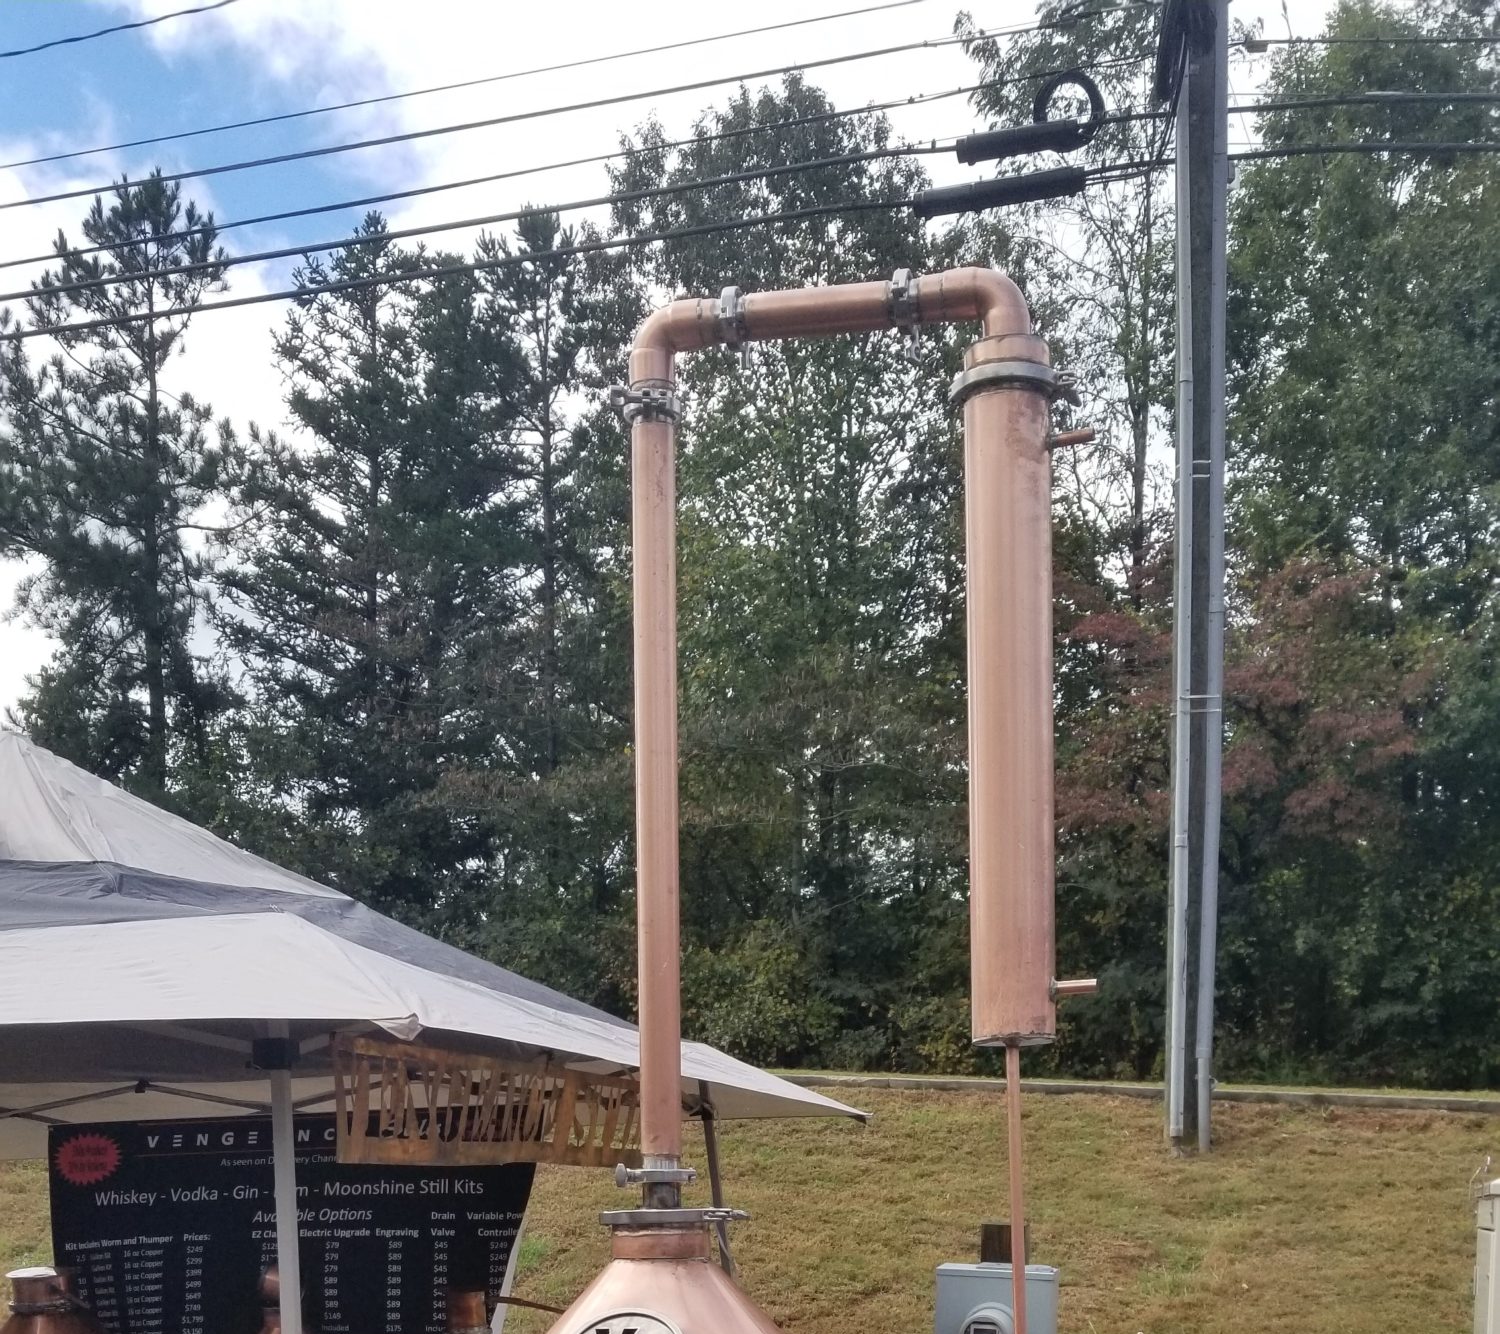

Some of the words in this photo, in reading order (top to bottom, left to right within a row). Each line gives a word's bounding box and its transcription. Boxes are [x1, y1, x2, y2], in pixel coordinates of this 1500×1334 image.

[147, 1128, 336, 1149] VENGENC
[221, 1158, 231, 1167] As
[232, 1158, 252, 1167] seen
[255, 1157, 266, 1166] on
[95, 1188, 157, 1206] Whiskey
[170, 1186, 218, 1202] Vodka
[233, 1185, 259, 1200] Gin
[324, 1179, 415, 1196] Moonshine
[419, 1178, 449, 1195] Still
[454, 1178, 484, 1195] Kits
[252, 1208, 316, 1223] Avable
[319, 1207, 373, 1224] Options
[431, 1211, 456, 1220] Drain
[467, 1211, 504, 1220] Variable
[251, 1230, 262, 1239] EZ
[263, 1230, 278, 1239] Cla
[300, 1228, 332, 1237] Electric
[333, 1228, 371, 1239] Upgrade
[375, 1228, 419, 1239] Engraving
[430, 1228, 456, 1237] Valve
[478, 1227, 519, 1237] Controlle
[65, 1242, 77, 1251] Kit
[101, 1238, 122, 1247] Worm
[123, 1236, 137, 1246] and
[138, 1234, 173, 1245] Thumper
[183, 1232, 211, 1243] Prices:
[141, 1248, 164, 1258] Copper
[325, 1241, 340, 1249] $79
[388, 1241, 402, 1249] $89
[434, 1241, 448, 1249] $45
[140, 1259, 164, 1269] Copper
[324, 1253, 339, 1261] $79
[388, 1253, 402, 1261] $89
[434, 1252, 448, 1261] $45
[140, 1271, 164, 1280] Copper
[324, 1264, 338, 1272] $79
[387, 1265, 402, 1273] $89
[433, 1264, 448, 1273] $45
[324, 1276, 338, 1284] $89
[387, 1276, 401, 1285] $89
[433, 1276, 448, 1285] $45
[324, 1288, 338, 1297] $89
[387, 1288, 401, 1296] $89
[325, 1300, 338, 1308] $89
[386, 1300, 401, 1308] $89
[386, 1312, 401, 1320] $89
[432, 1312, 447, 1320] $45
[386, 1324, 402, 1332] $175
